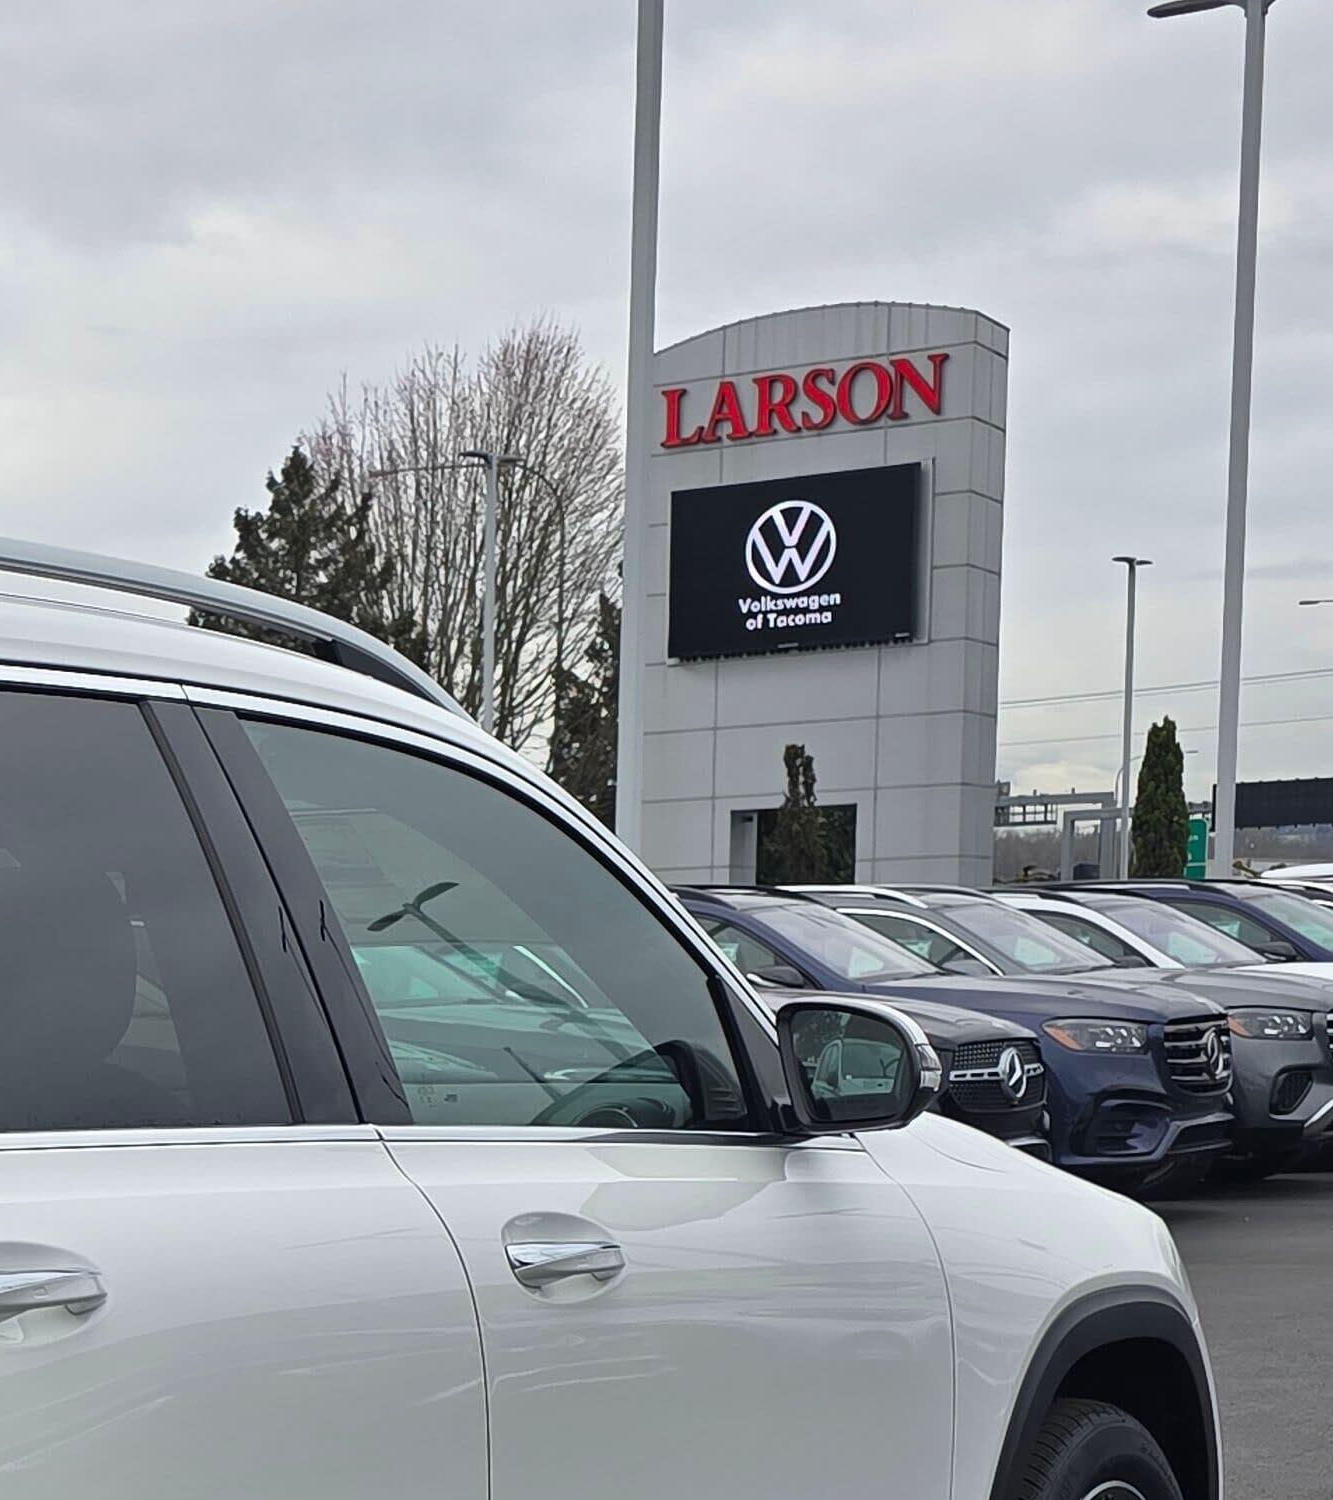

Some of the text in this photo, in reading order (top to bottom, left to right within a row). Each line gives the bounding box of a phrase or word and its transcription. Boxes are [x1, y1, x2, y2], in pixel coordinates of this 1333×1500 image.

[660, 353, 950, 449] LARSON
[738, 592, 841, 614] Volkswagen
[745, 610, 832, 631] of Tacoma
